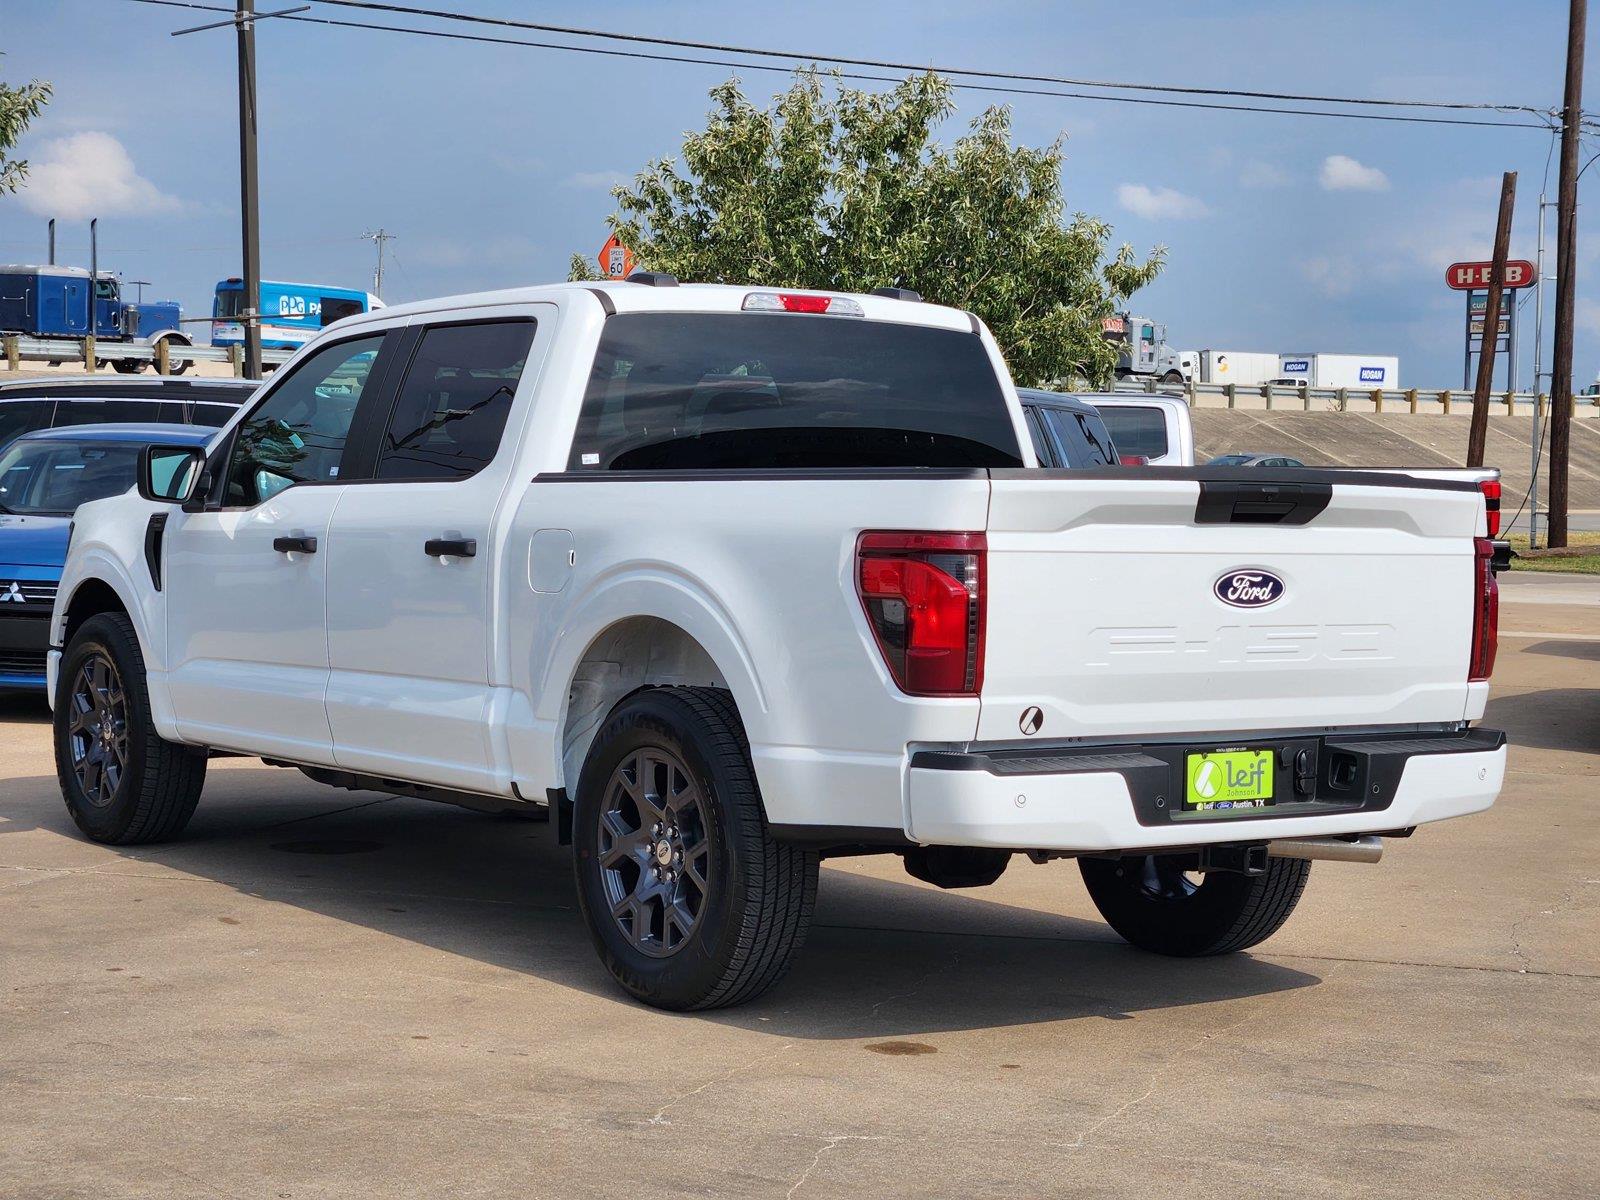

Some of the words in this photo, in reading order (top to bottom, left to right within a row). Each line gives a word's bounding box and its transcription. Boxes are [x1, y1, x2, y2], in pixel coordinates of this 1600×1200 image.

[610, 263, 623, 274] 60
[1457, 266, 1523, 284] H-EB
[280, 296, 305, 318] PPG
[1286, 363, 1307, 371] HOGAN
[1361, 369, 1384, 380] HOGAN
[1228, 575, 1274, 600] Ford
[1084, 624, 1397, 667] F-150
[1226, 758, 1267, 794] leif
[1226, 789, 1255, 797] Johnson
[1255, 799, 1265, 807] TX
